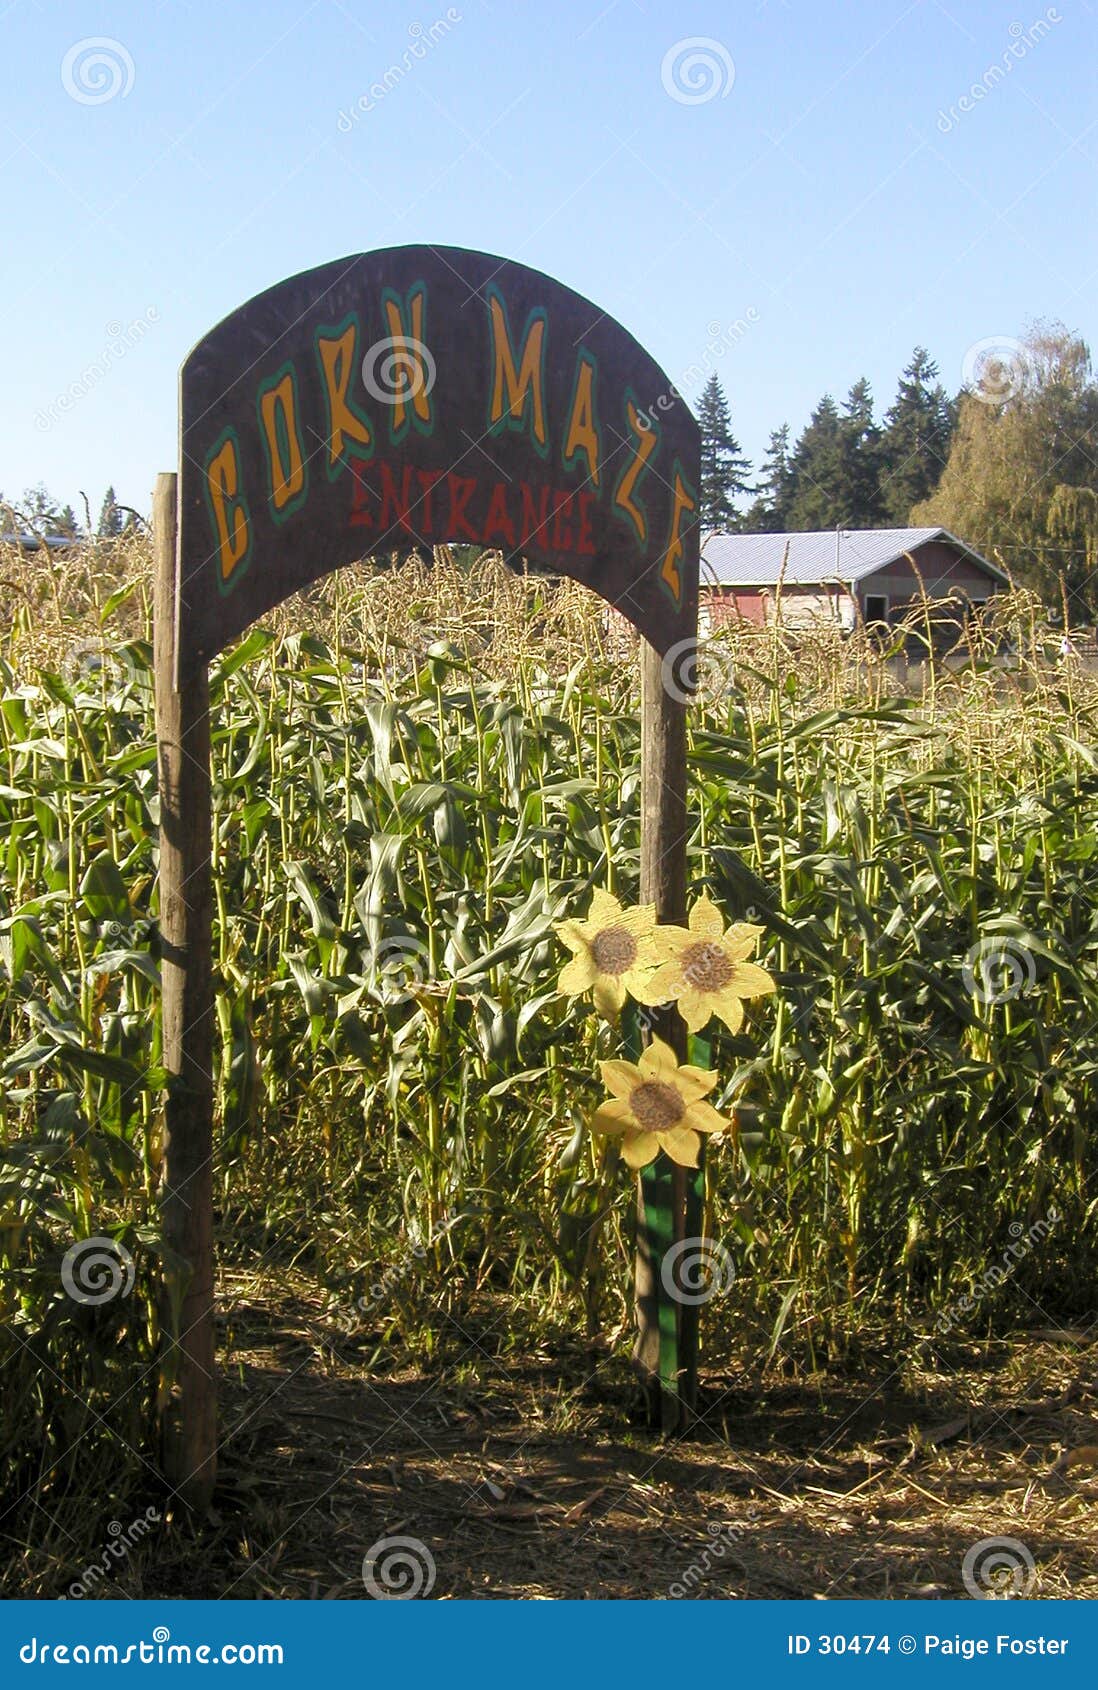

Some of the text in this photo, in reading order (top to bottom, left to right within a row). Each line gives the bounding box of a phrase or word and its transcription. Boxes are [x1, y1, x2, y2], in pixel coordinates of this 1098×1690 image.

[206, 281, 698, 613] CORN MAZE
[350, 457, 597, 555] ENTRANCE
